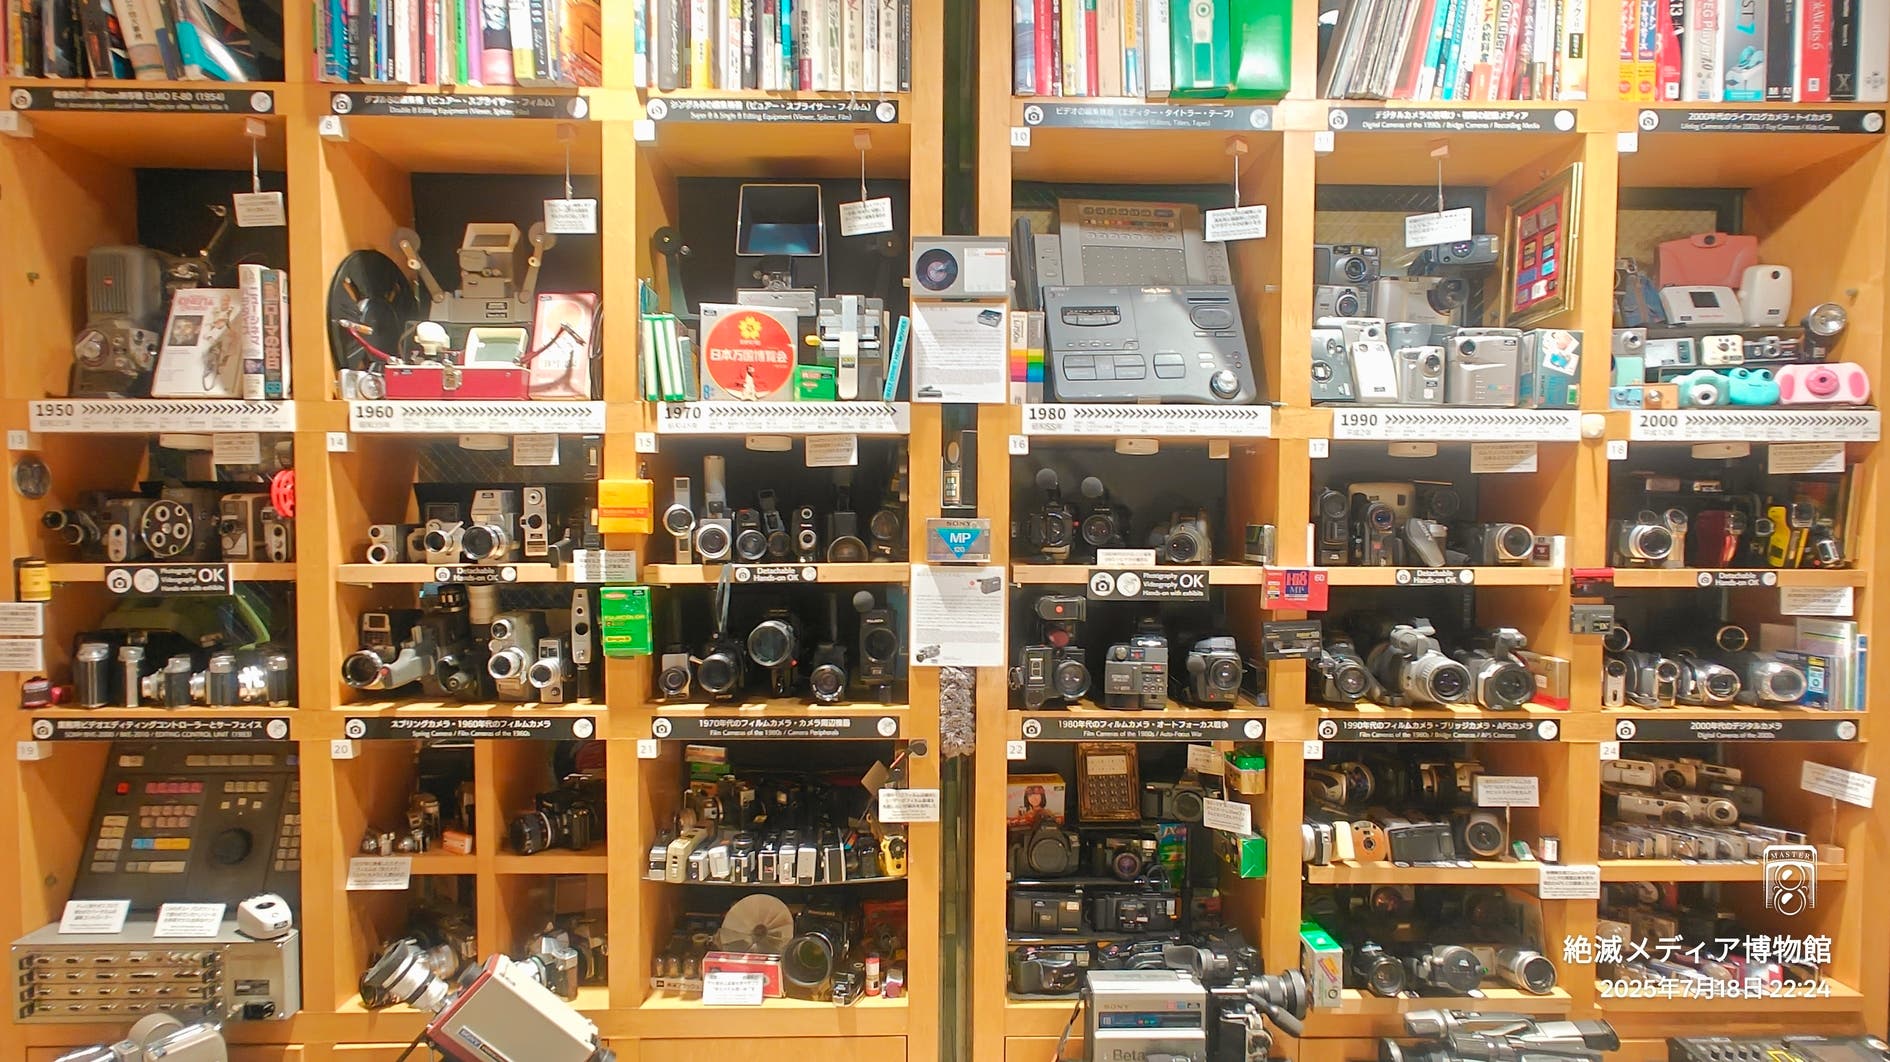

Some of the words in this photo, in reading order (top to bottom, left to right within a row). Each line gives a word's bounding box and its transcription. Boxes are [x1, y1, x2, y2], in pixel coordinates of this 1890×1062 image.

[36, 404, 74, 416] 1950
[355, 406, 394, 418] 1960
[665, 407, 701, 419] 1970
[1029, 407, 1066, 420] 1980
[1341, 414, 1378, 426] 1990
[1640, 415, 1678, 427] 2000
[950, 533, 971, 543] MP
[198, 568, 225, 582] OK
[1179, 574, 1204, 588] OK
